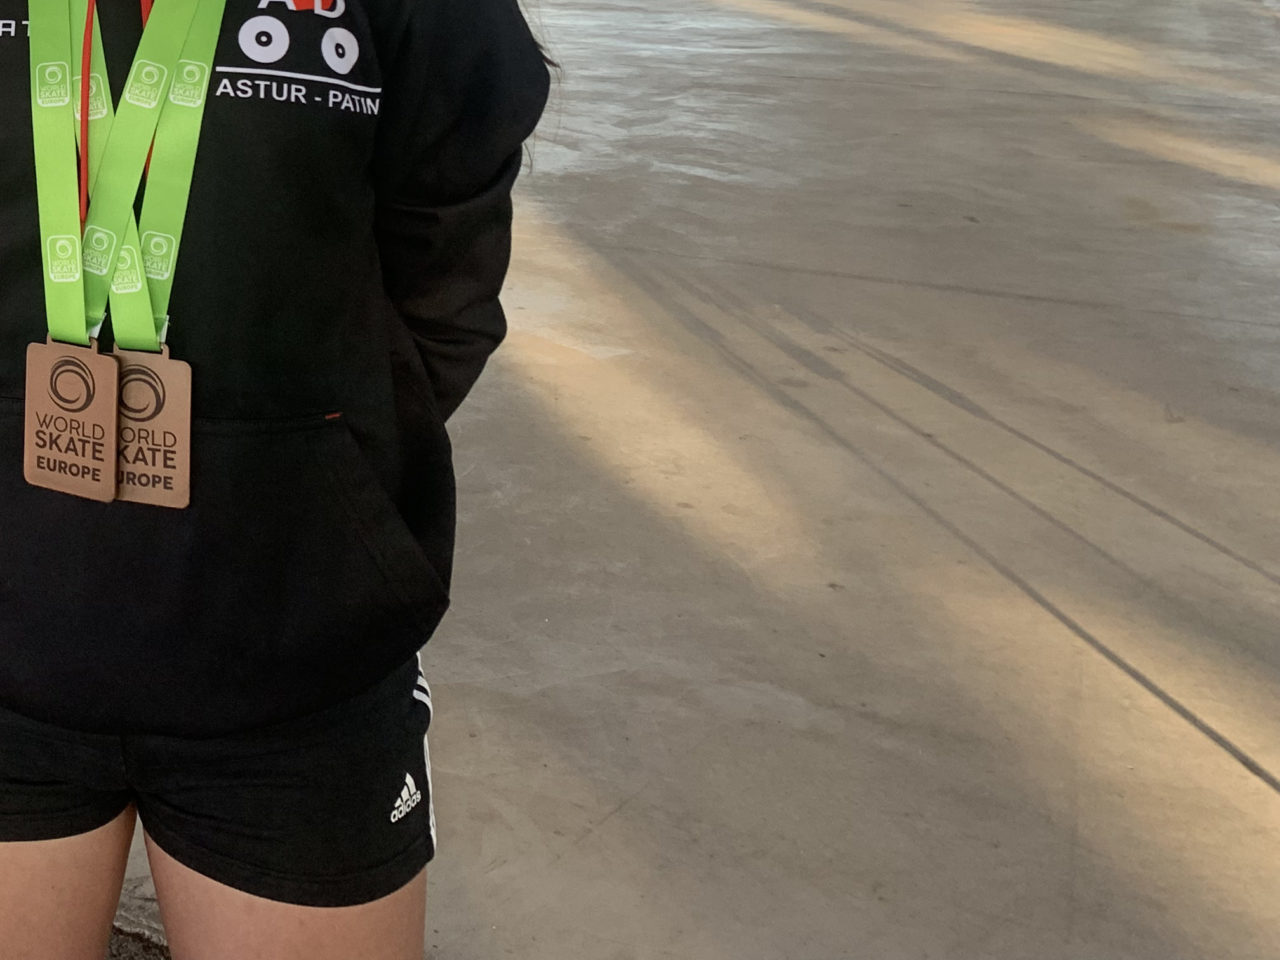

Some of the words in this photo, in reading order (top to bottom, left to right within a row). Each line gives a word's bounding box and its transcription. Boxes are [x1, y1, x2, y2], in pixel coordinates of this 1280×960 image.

[215, 78, 308, 104] ASTUR
[328, 90, 381, 115] PATIN
[35, 411, 105, 441] WORLD
[120, 426, 177, 448] ORLD
[34, 429, 105, 462] SKATE
[119, 444, 177, 470] KATE
[36, 455, 102, 482] EUROPE
[389, 790, 422, 823] adidas
